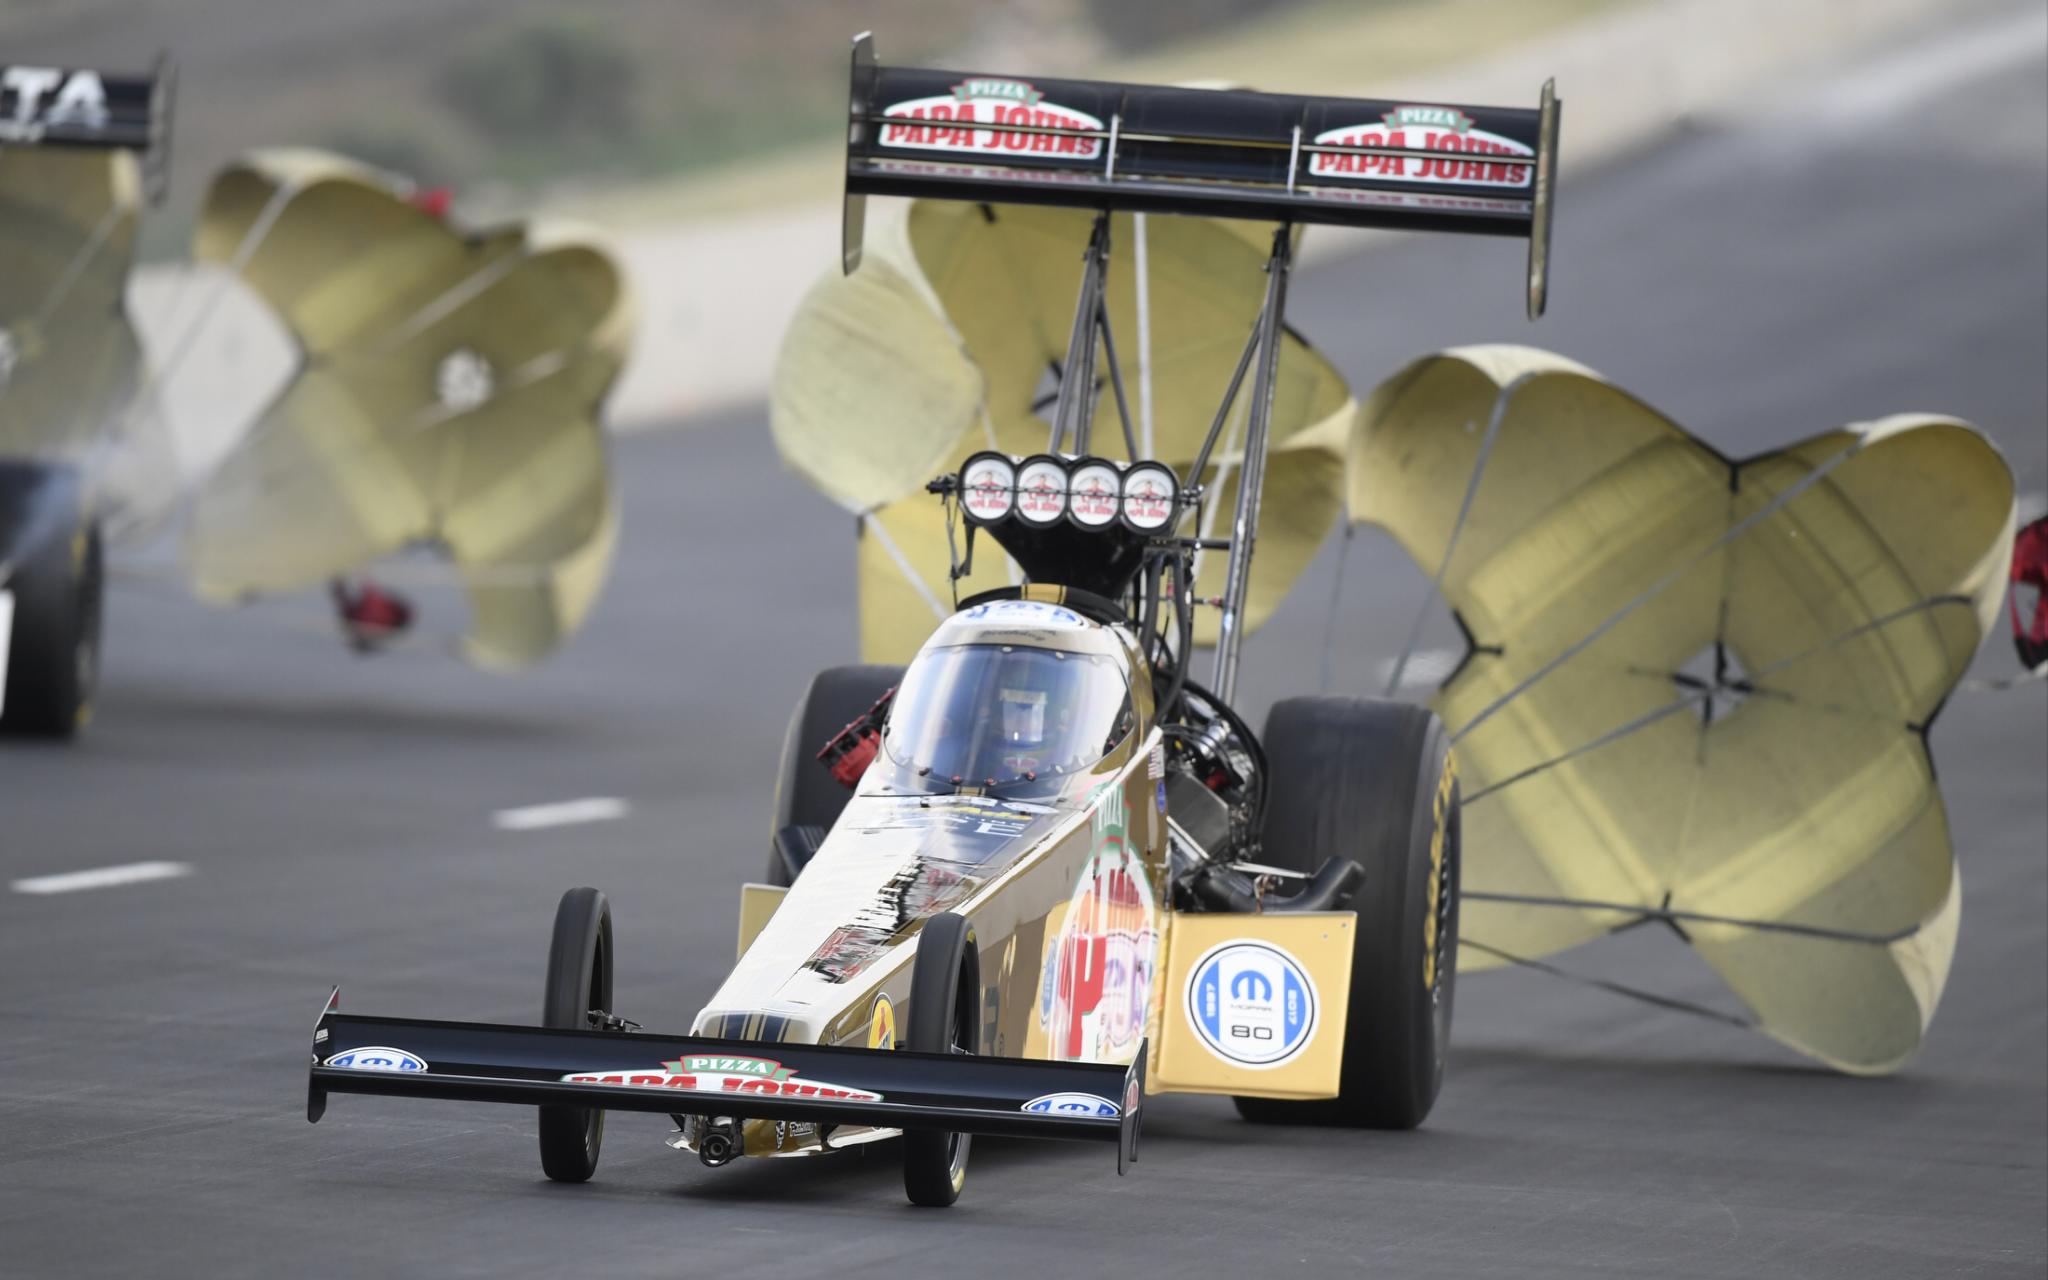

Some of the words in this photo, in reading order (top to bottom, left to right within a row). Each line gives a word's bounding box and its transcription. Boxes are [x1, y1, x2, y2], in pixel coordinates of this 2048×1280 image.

[970, 81, 1026, 99] PIZZA
[1400, 109, 1456, 126] PIZZA
[887, 104, 976, 146] PAPA
[983, 105, 1097, 155] JOHNS
[1317, 132, 1406, 176] PAPA
[1413, 133, 1527, 184] JOHNS
[1231, 1024, 1273, 1040] 80
[691, 1057, 769, 1075] PIZZA
